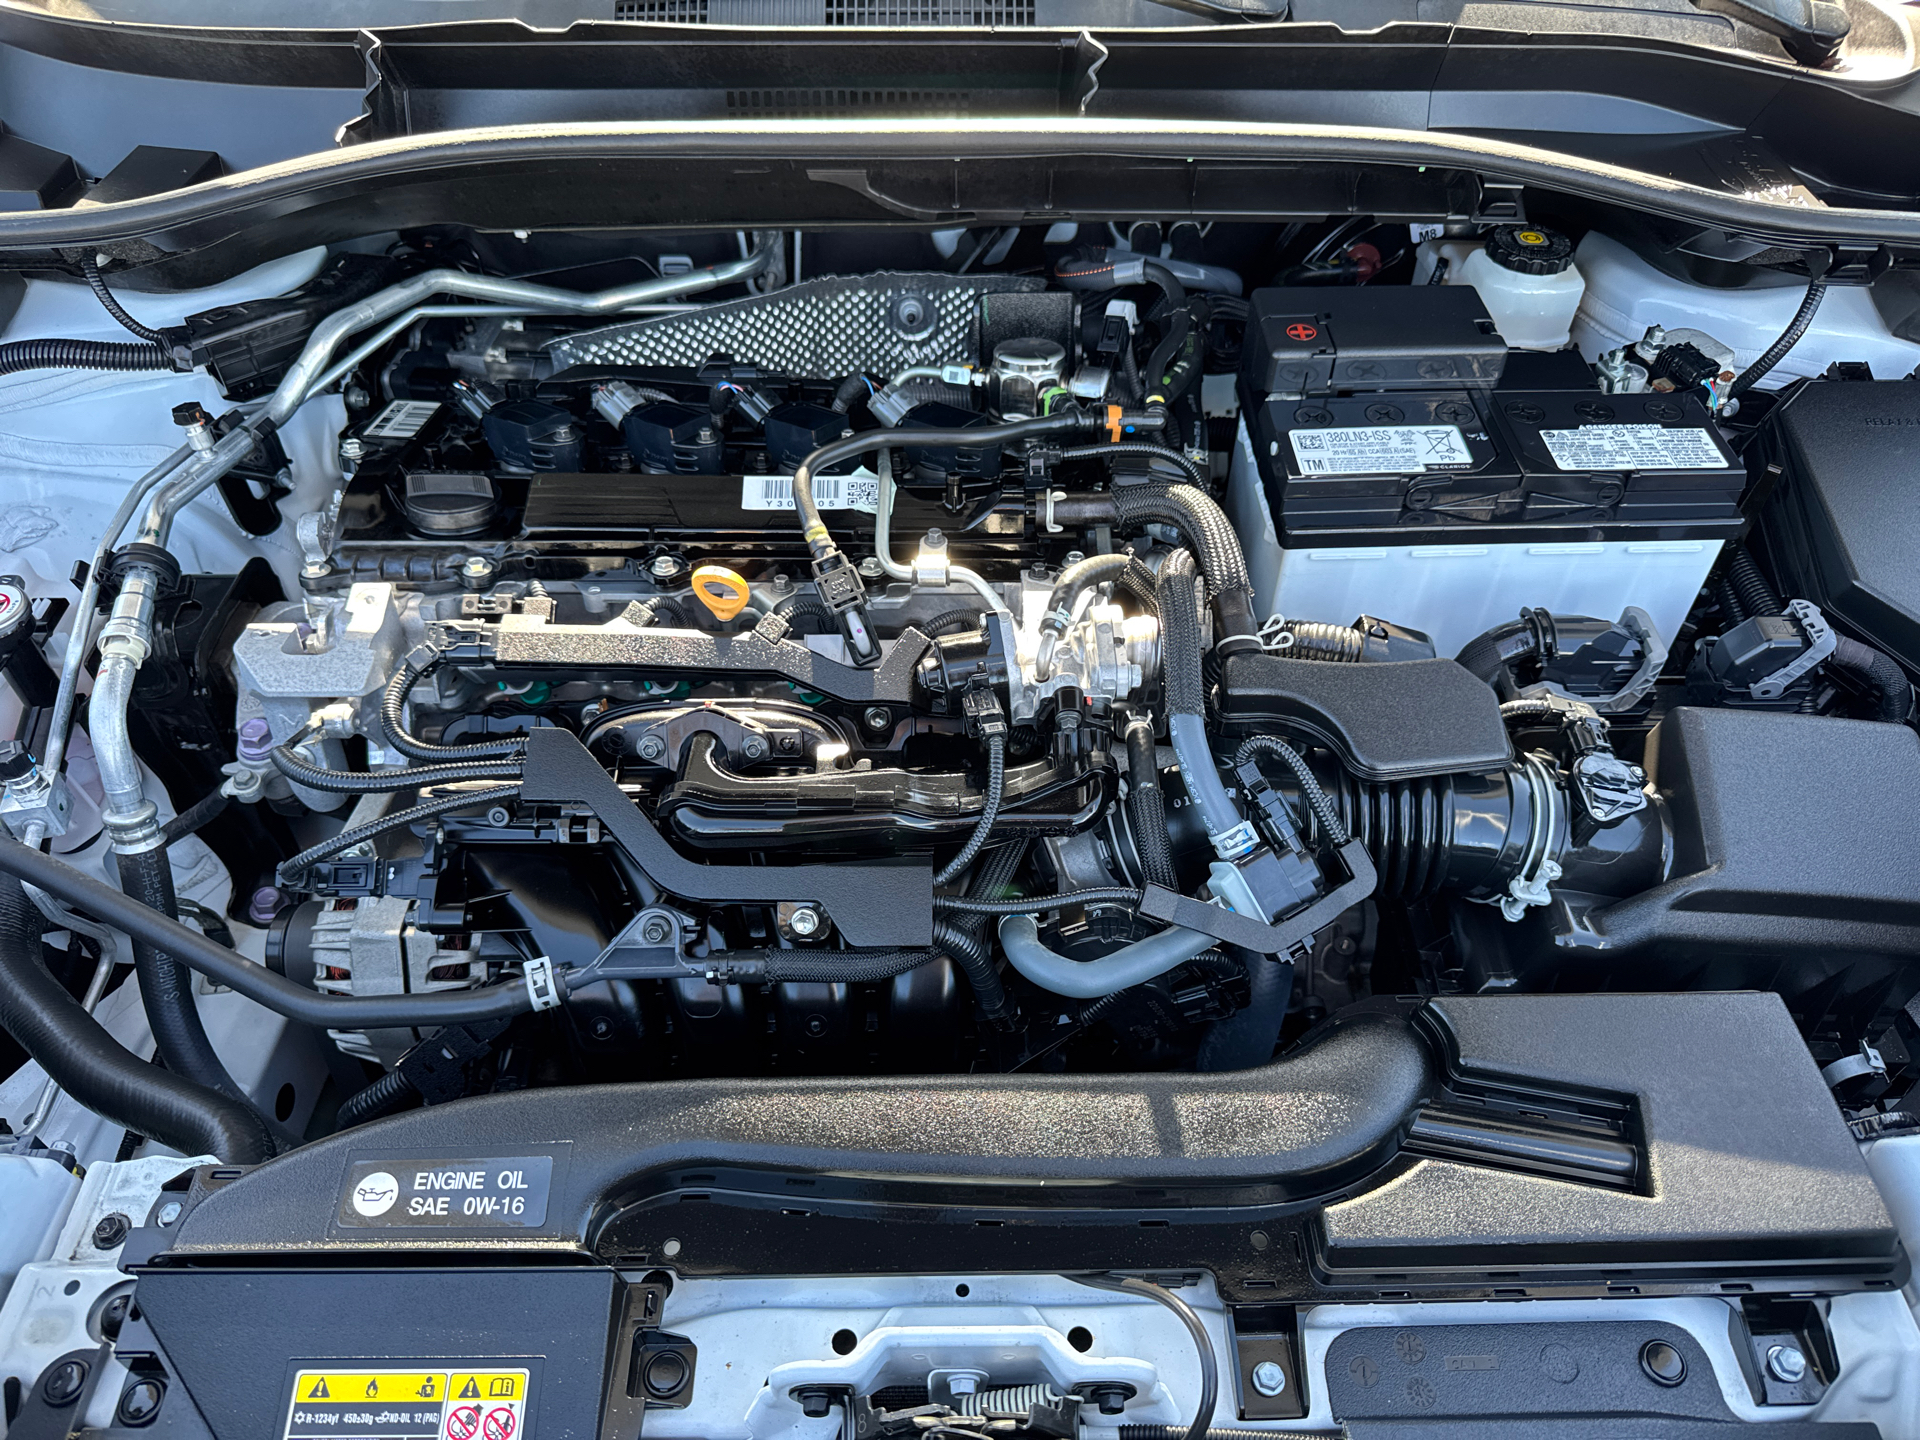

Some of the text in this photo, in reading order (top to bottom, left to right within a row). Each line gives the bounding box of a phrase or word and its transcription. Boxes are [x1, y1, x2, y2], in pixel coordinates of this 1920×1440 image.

[1418, 228, 1437, 242] M8
[1326, 430, 1391, 443] 380LN3-ISS
[1304, 459, 1325, 471] TM
[413, 1170, 528, 1190] ENGINE OIL
[408, 1196, 525, 1216] SAE 0W-16
[342, 1412, 374, 1425] 450±30g
[389, 1412, 411, 1423] ND-OIL
[413, 1412, 422, 1423] 12
[422, 1412, 440, 1425] (PAG)
